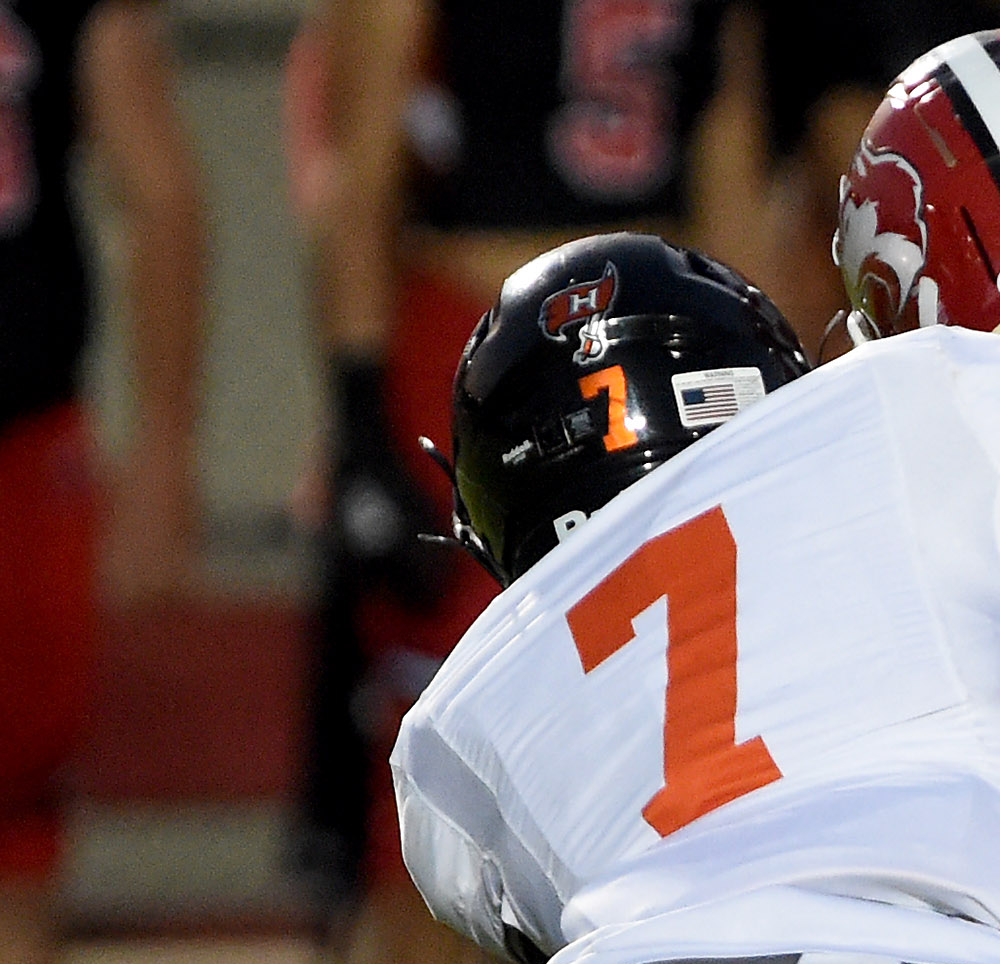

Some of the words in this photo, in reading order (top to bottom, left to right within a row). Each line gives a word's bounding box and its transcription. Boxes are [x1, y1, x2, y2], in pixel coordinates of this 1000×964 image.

[569, 286, 598, 315] H
[578, 364, 639, 453] 7
[565, 503, 784, 839] 7
